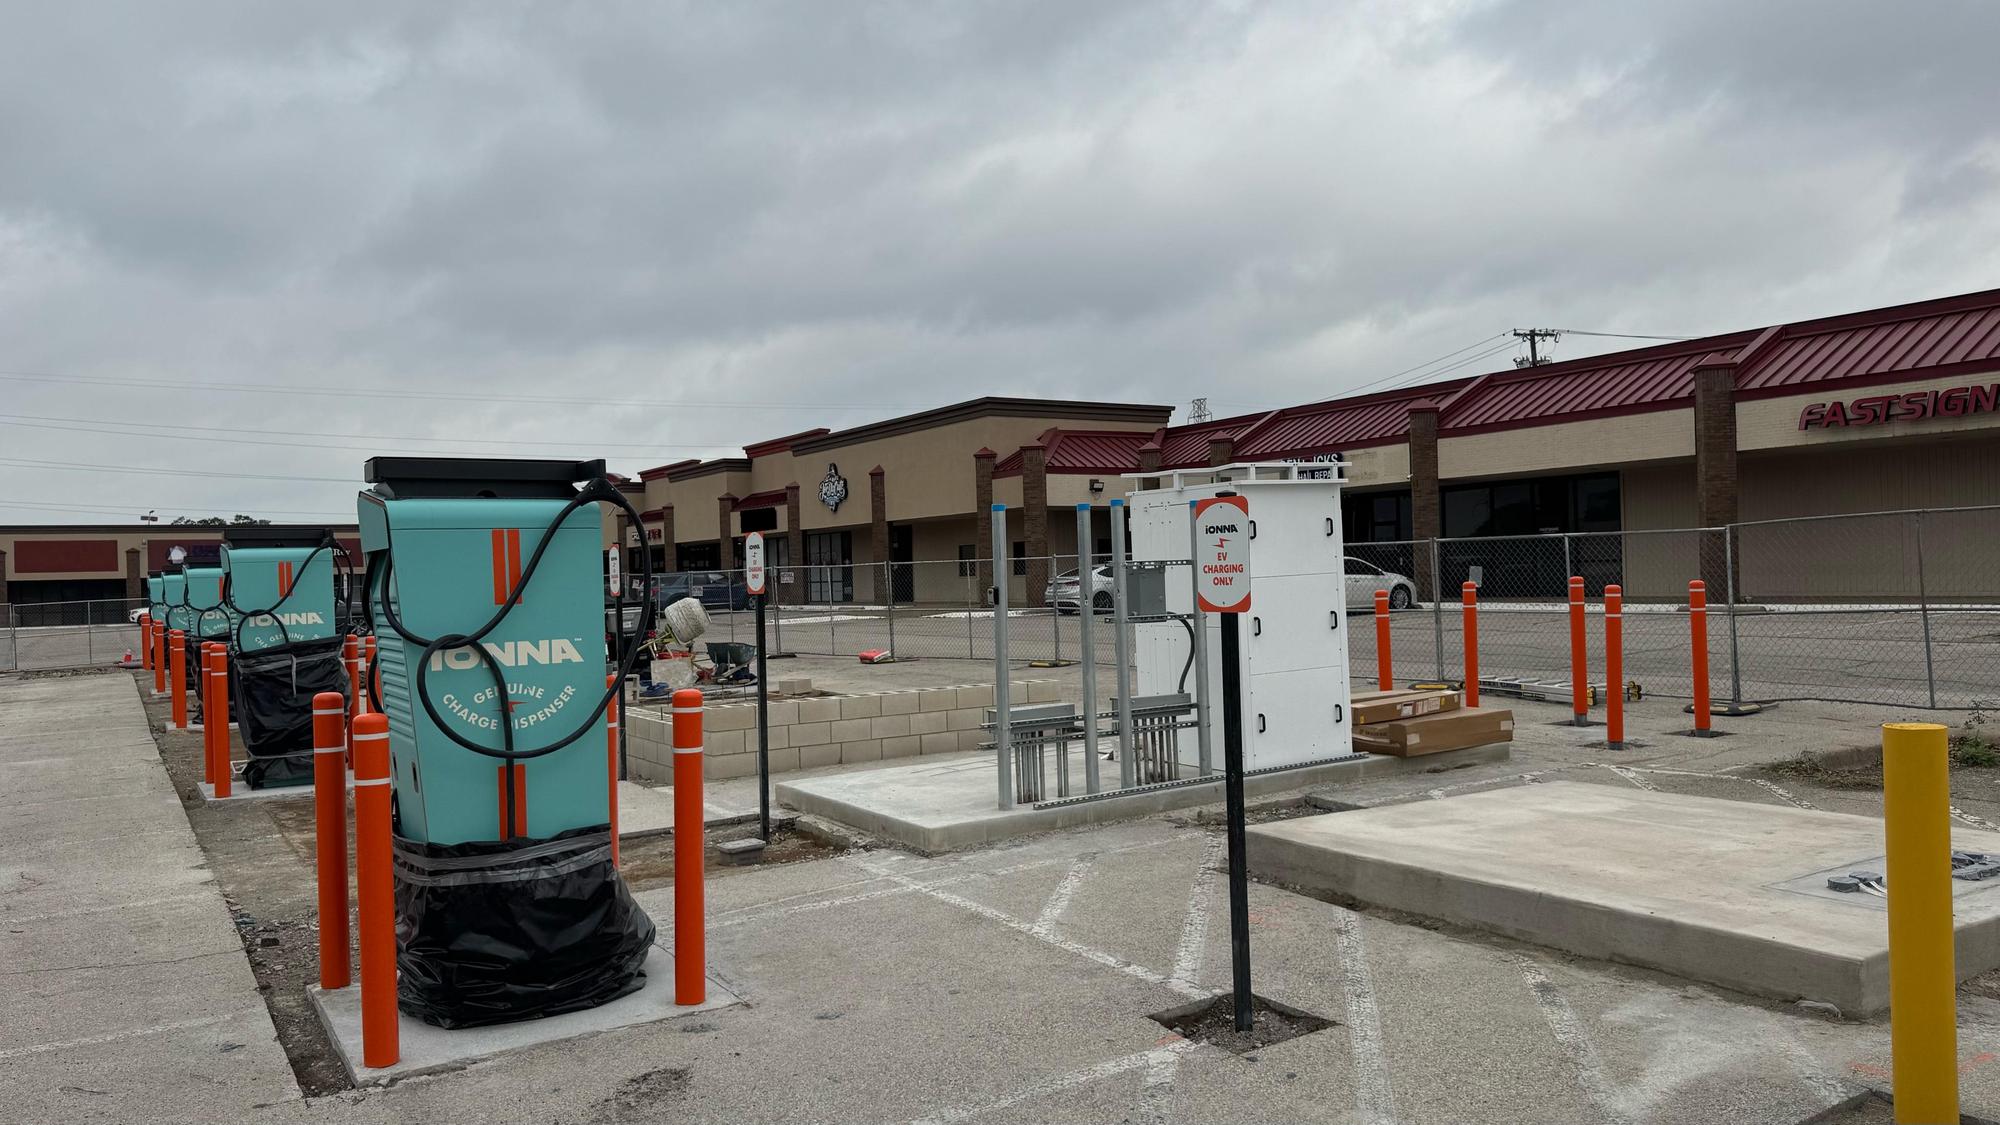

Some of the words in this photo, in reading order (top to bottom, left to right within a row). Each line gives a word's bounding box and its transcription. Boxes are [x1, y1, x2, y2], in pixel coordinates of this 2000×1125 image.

[1217, 552, 1227, 561] EV
[1203, 564, 1244, 574] CHARGING
[1213, 577, 1234, 586] ONLY
[443, 694, 498, 730] CHARGE
[512, 685, 577, 730] ISPENSER
